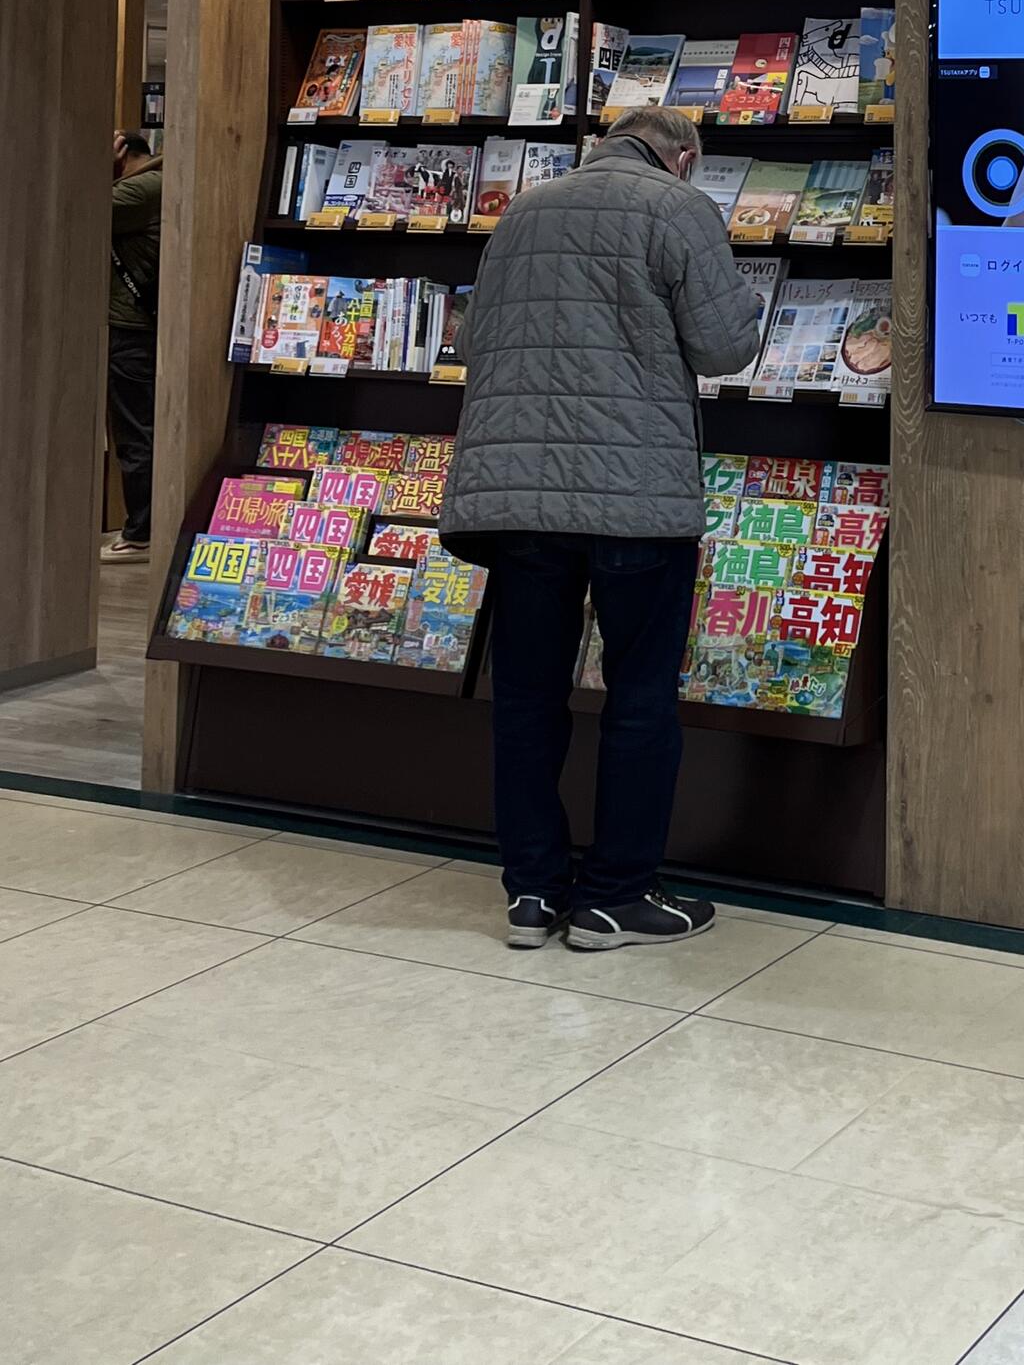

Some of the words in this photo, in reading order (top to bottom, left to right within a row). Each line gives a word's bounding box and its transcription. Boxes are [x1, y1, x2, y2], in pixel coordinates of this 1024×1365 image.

[960, 312, 998, 324] いつでも
[391, 474, 444, 511] 温泉
[738, 503, 808, 545] 徳島
[187, 541, 251, 584] 四国
[423, 561, 473, 606] 愛媛
[714, 544, 785, 588] 徳島
[344, 571, 397, 609] 愛媛
[706, 590, 769, 639] 香川
[780, 596, 861, 646] 高知
